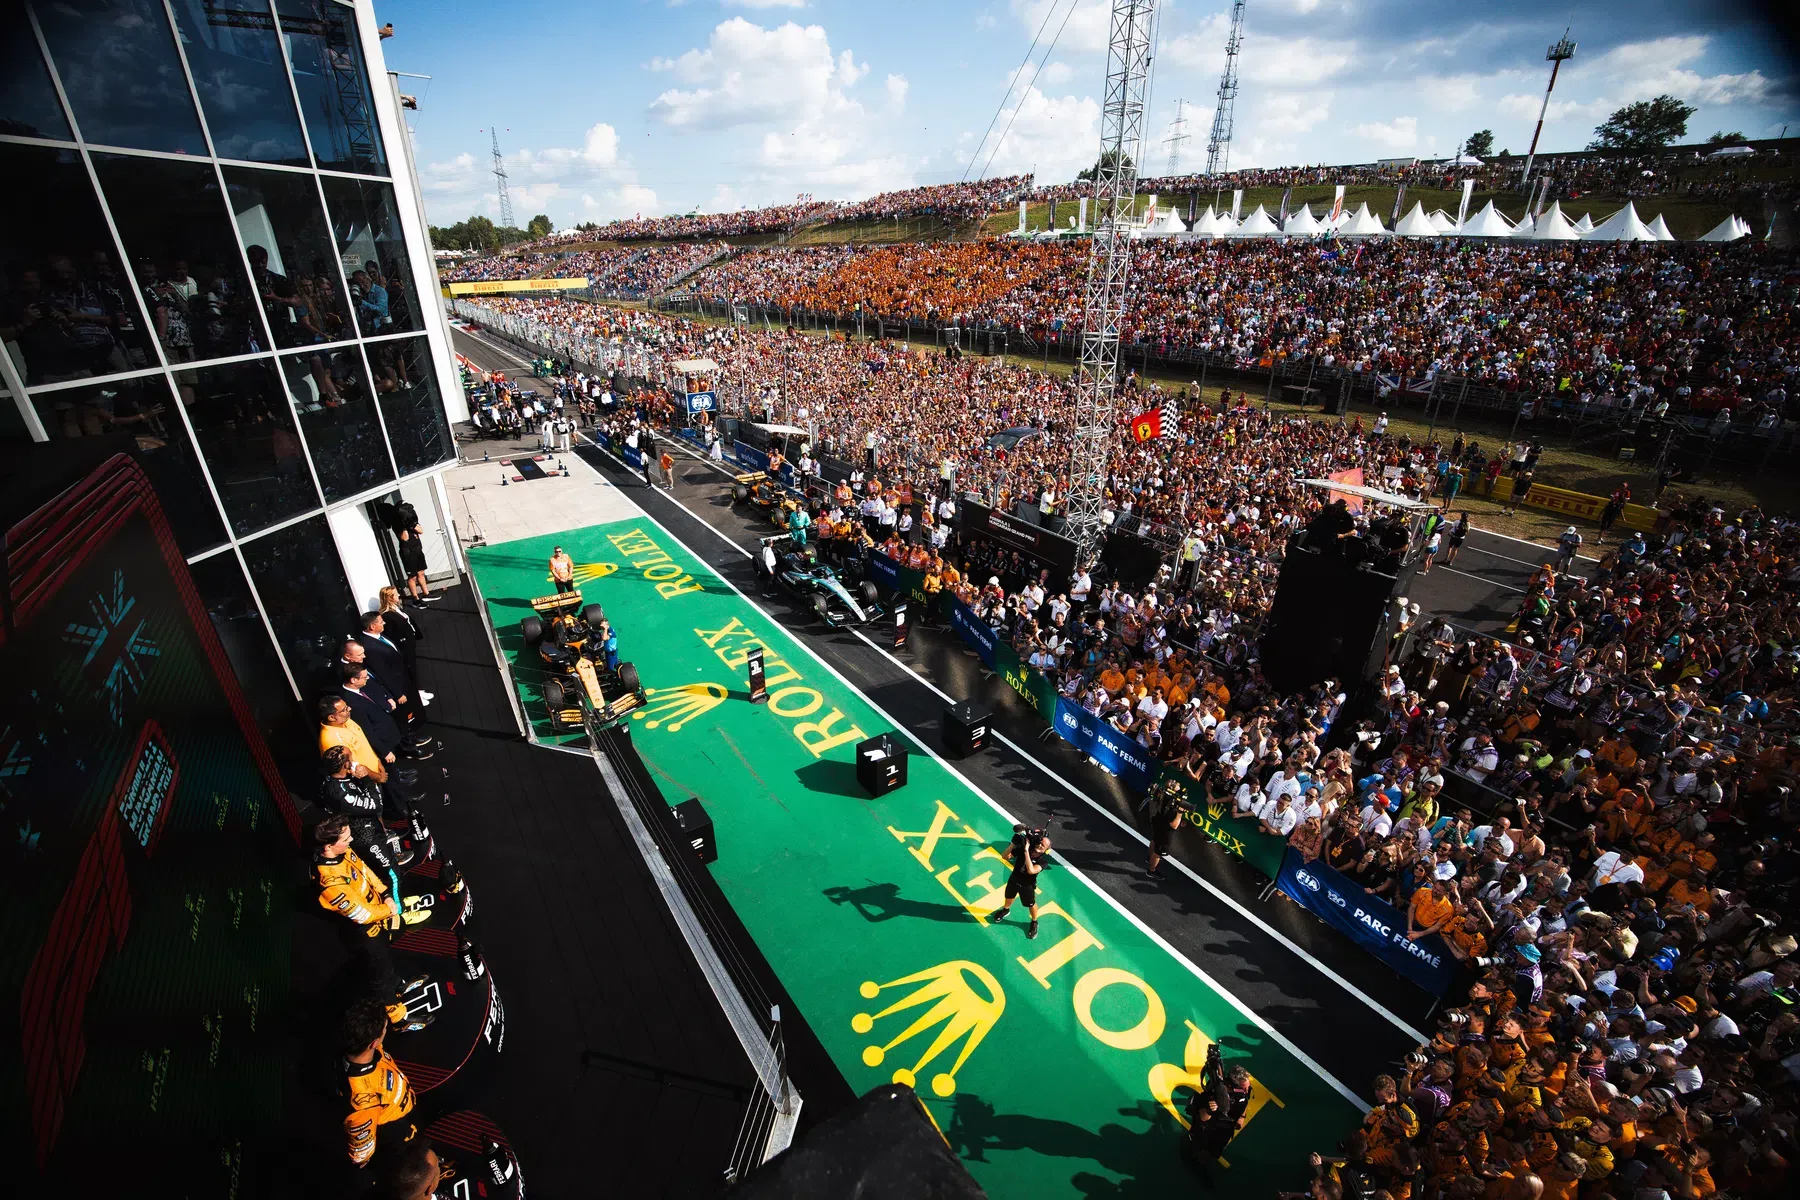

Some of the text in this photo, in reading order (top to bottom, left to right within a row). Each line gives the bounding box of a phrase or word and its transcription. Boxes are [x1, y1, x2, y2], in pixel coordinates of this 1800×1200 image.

[473, 283, 504, 292] PIRELLI
[530, 281, 559, 289] PIRELLI
[692, 395, 712, 409] FIA
[1525, 490, 1598, 516] IRELLI
[606, 528, 705, 600] ROLEX
[751, 661, 762, 676] 1
[694, 617, 870, 759] ROLEX
[1005, 670, 1039, 710] ROLEX
[971, 726, 986, 740] 3
[1063, 714, 1078, 729] FIA
[1097, 735, 1119, 754] PARC
[1119, 750, 1147, 773] FERMÉ
[886, 764, 899, 777] 1
[1296, 870, 1320, 891] FIA
[1353, 908, 1391, 937] PARC
[1393, 932, 1441, 968] FERMÉ
[463, 954, 479, 980] FERRARI
[488, 1159, 506, 1185] FERRARI
